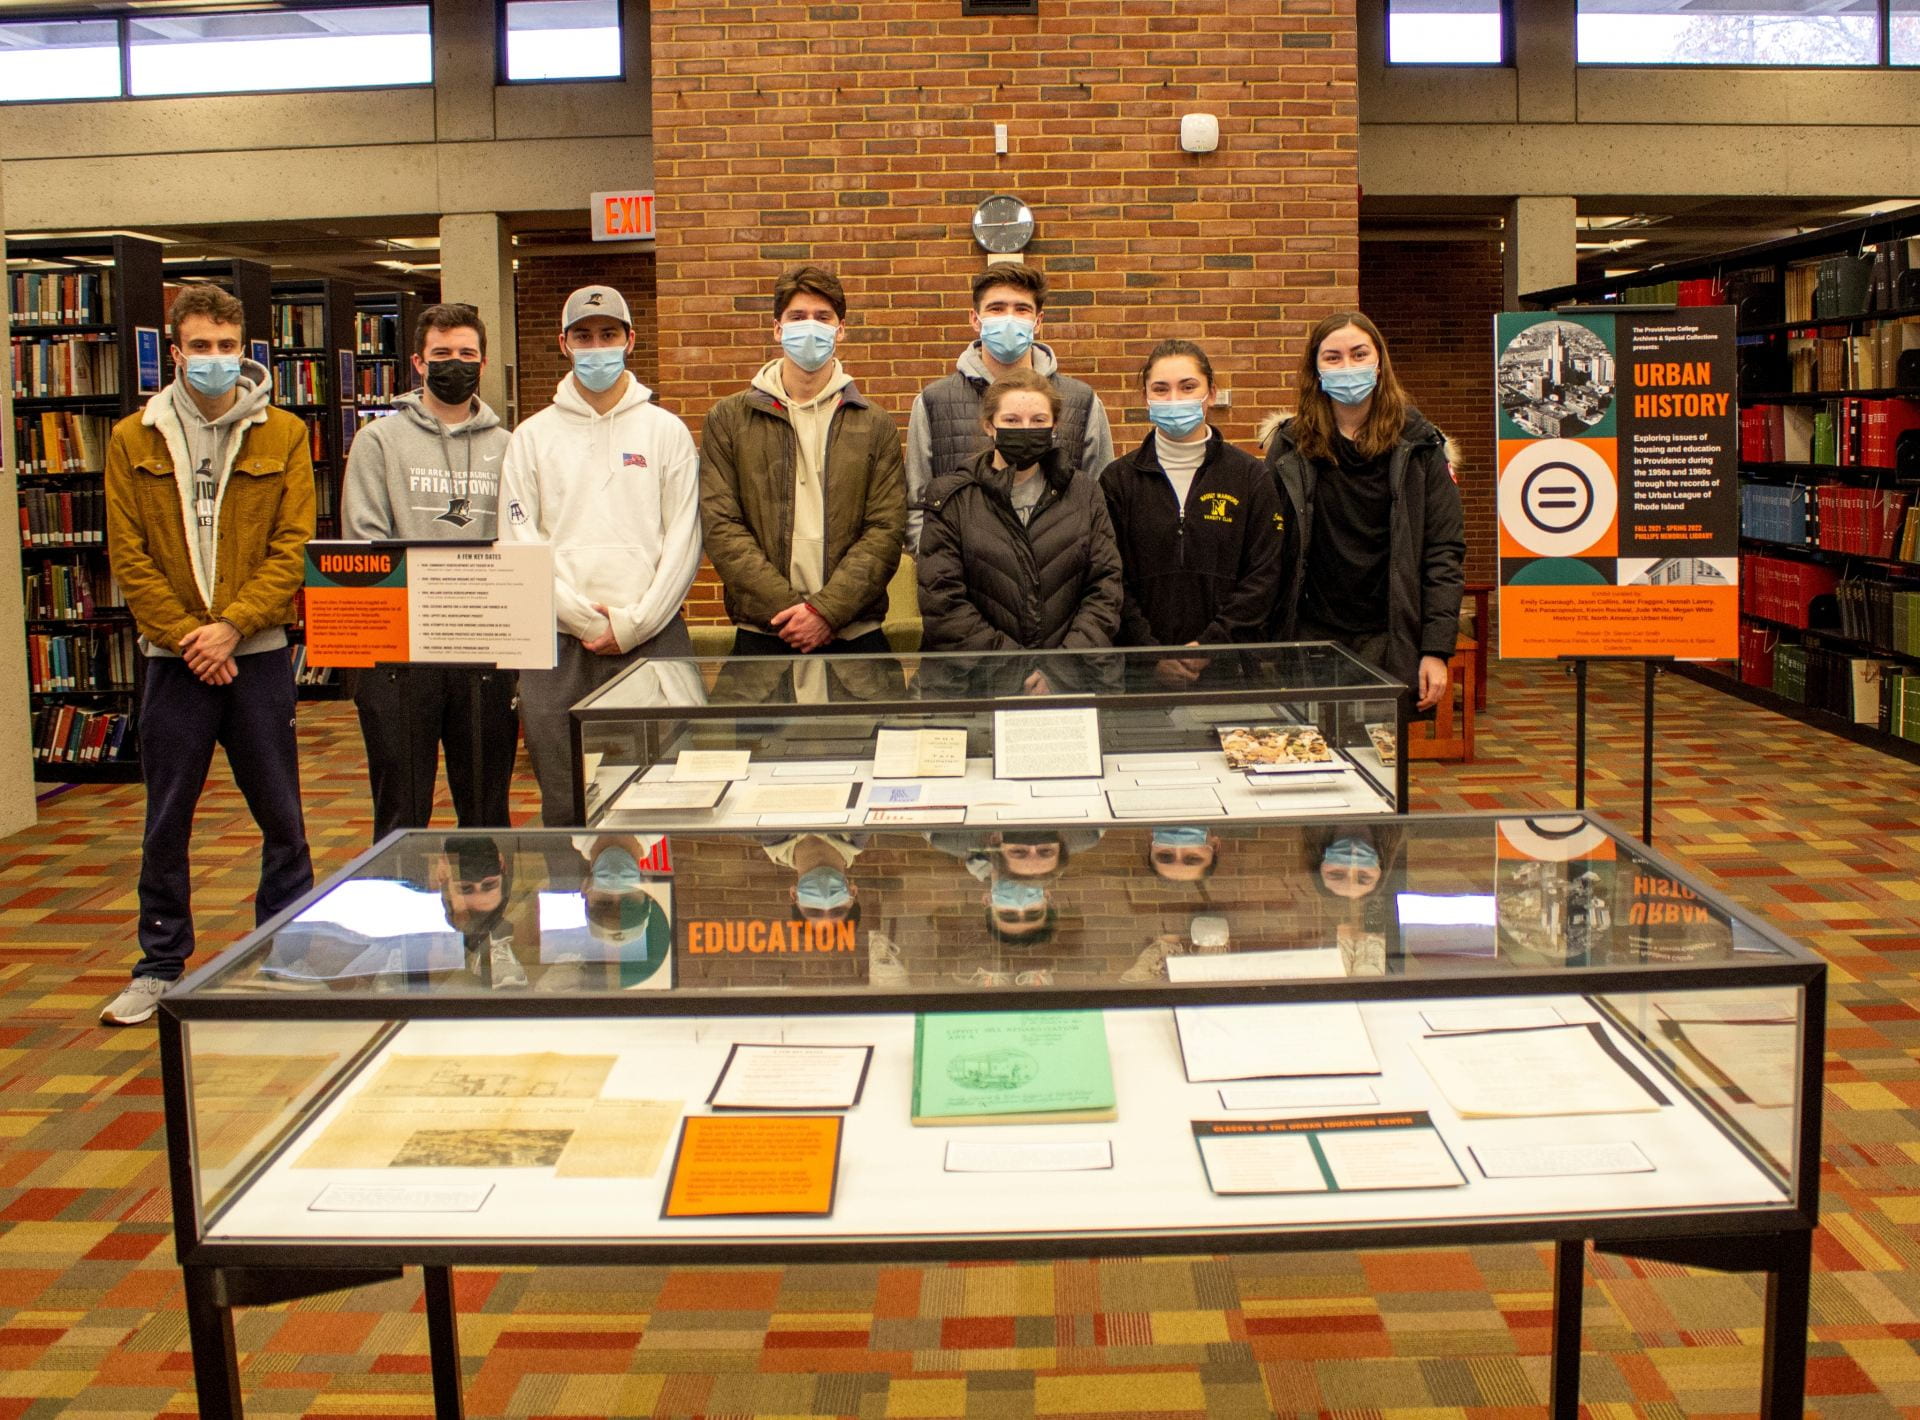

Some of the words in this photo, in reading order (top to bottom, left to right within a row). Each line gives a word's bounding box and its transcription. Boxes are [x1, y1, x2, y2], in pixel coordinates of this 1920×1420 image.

[605, 196, 654, 235] EXIT
[1634, 361, 1712, 387] URBAN
[1634, 392, 1730, 418] HISTORY
[1634, 434, 1671, 444] Exploring
[1634, 446, 1665, 454] housing
[1643, 457, 1687, 465] Providence
[1688, 456, 1714, 466] during
[410, 468, 426, 476] YOU
[428, 469, 444, 477] ARE
[470, 472, 490, 480] ALONE
[410, 476, 498, 497] FRIARTOWN
[1634, 480, 1665, 489] through
[1673, 492, 1702, 500] League
[1702, 490, 1712, 498] of
[1211, 498, 1227, 516] N
[1634, 503, 1660, 511] Rhode
[1661, 502, 1685, 510] Island
[320, 554, 392, 574] HOUSING
[687, 919, 856, 954] EDUCATION
[1270, 1124, 1286, 1132] THE
[1288, 1122, 1322, 1131] URBAN
[1324, 1120, 1376, 1129] EDUCATION
[1378, 1117, 1413, 1126] CENTER
